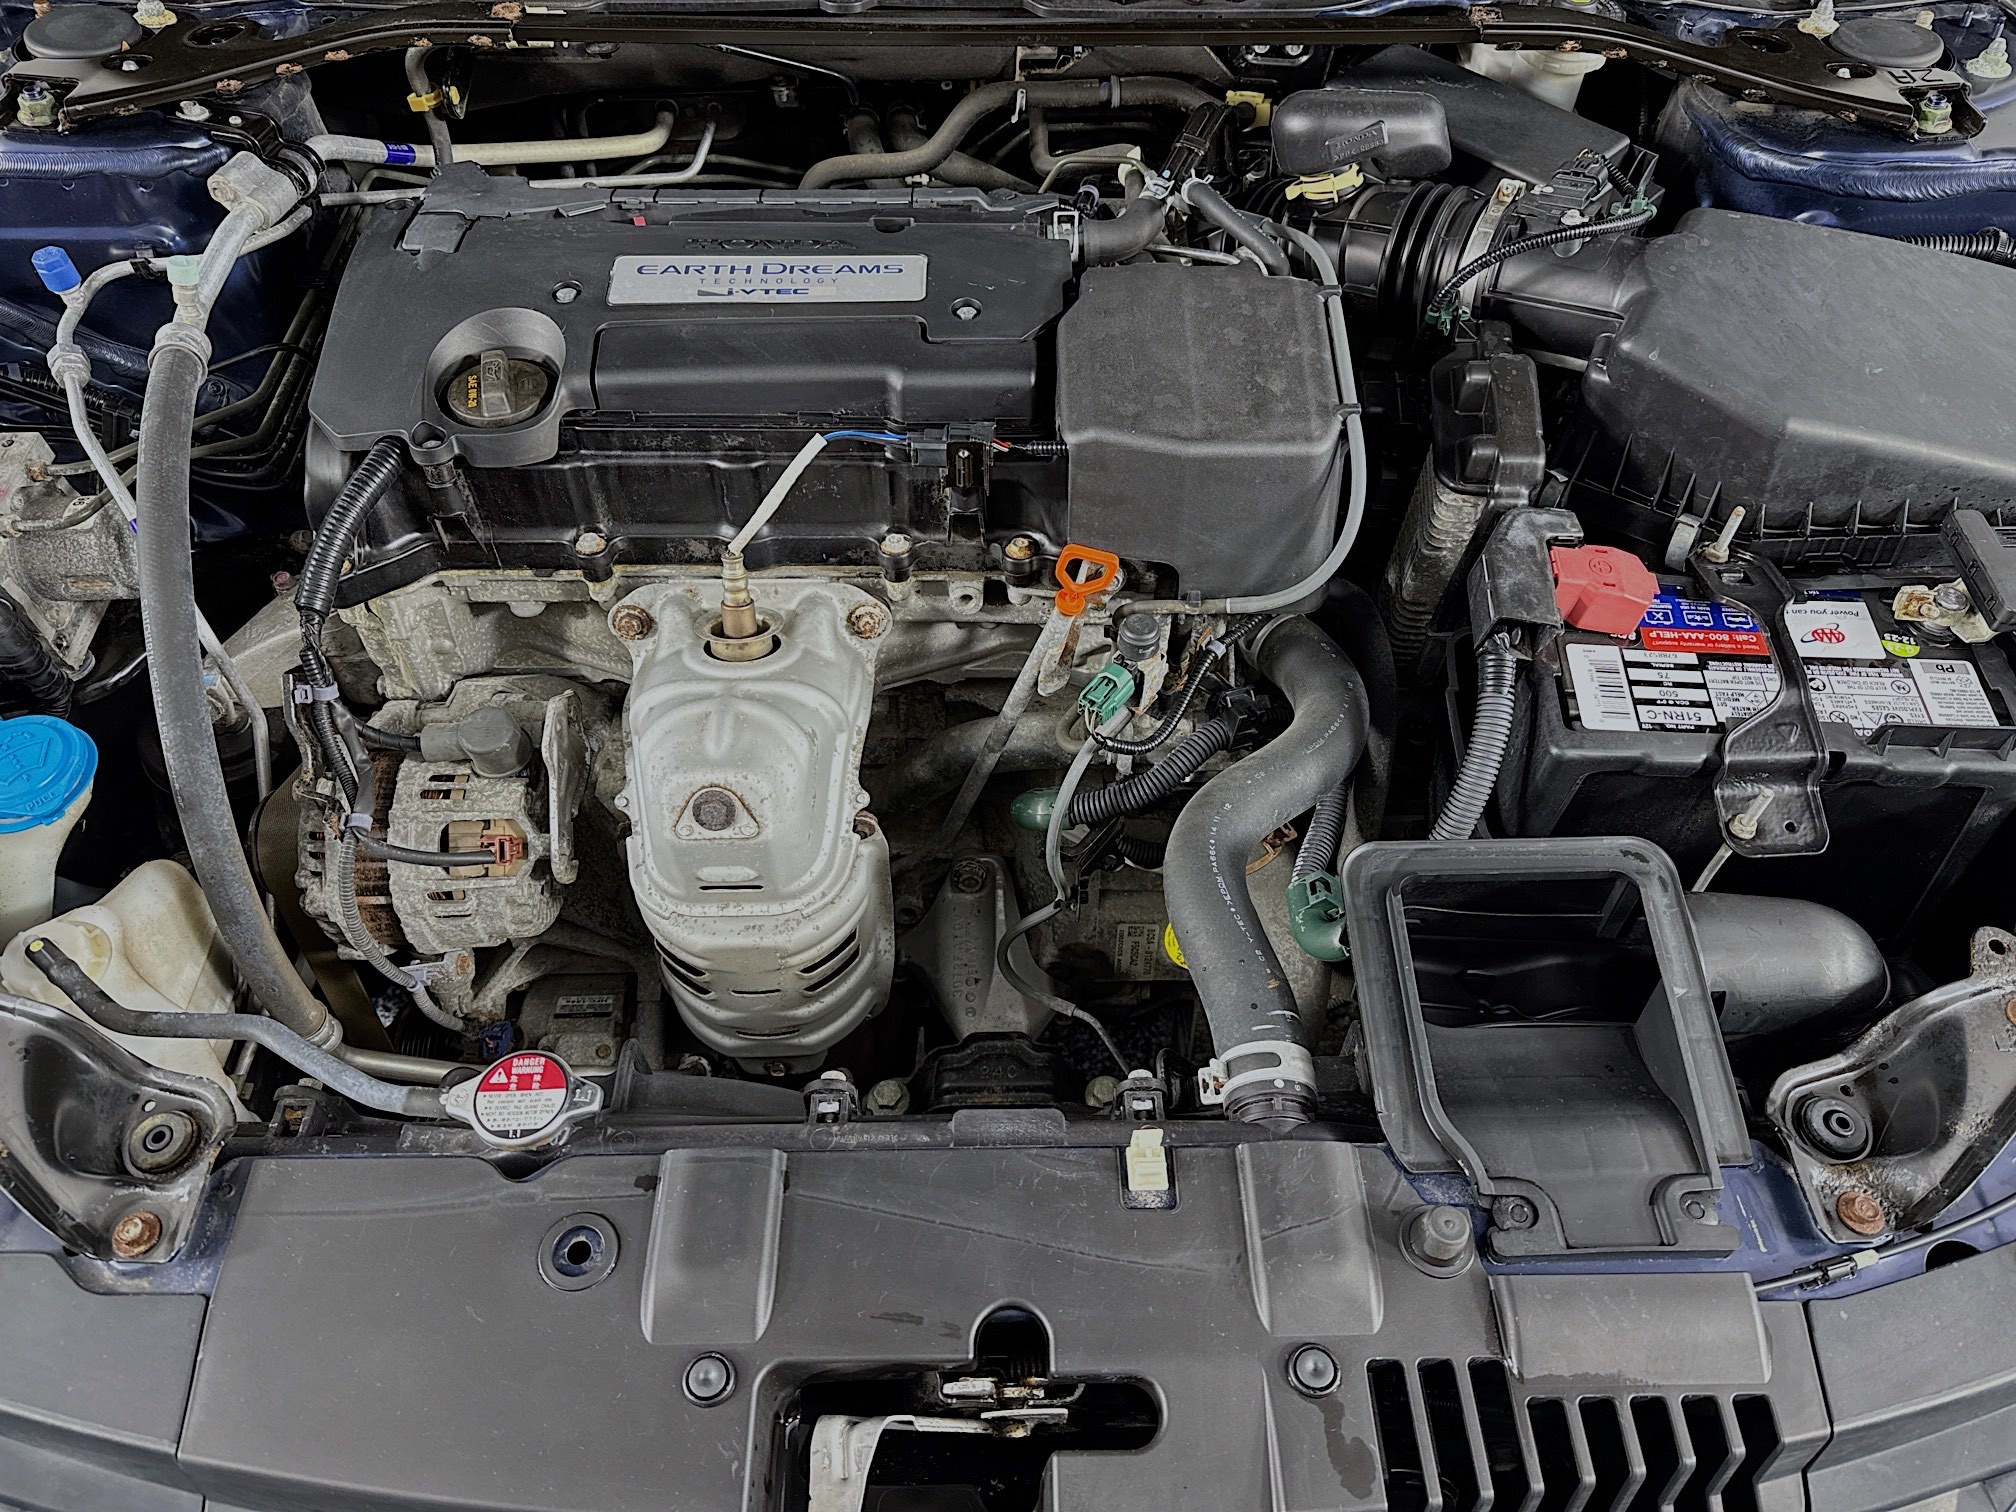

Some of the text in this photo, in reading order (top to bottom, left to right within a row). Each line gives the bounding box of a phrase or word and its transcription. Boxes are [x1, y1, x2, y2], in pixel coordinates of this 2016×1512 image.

[684, 237, 858, 250] HONDA
[636, 262, 904, 275] EARTH DREAMS
[699, 277, 840, 285] TECHNOLOGY
[727, 287, 810, 296] i-VTEC
[467, 374, 478, 408] SAE 0W-20
[1810, 608, 1828, 616] you
[1830, 609, 1859, 617] Power
[1649, 630, 1757, 642] Call: 800-AAA-HELP
[1813, 628, 1842, 644] AAA
[1884, 633, 1917, 645] 12-25
[1935, 664, 1956, 673] Pb
[1646, 709, 1702, 722] 51RN-C
[25, 791, 59, 811] PULL
[1232, 914, 1254, 943] Y-TEC
[512, 1057, 546, 1067] DANGER
